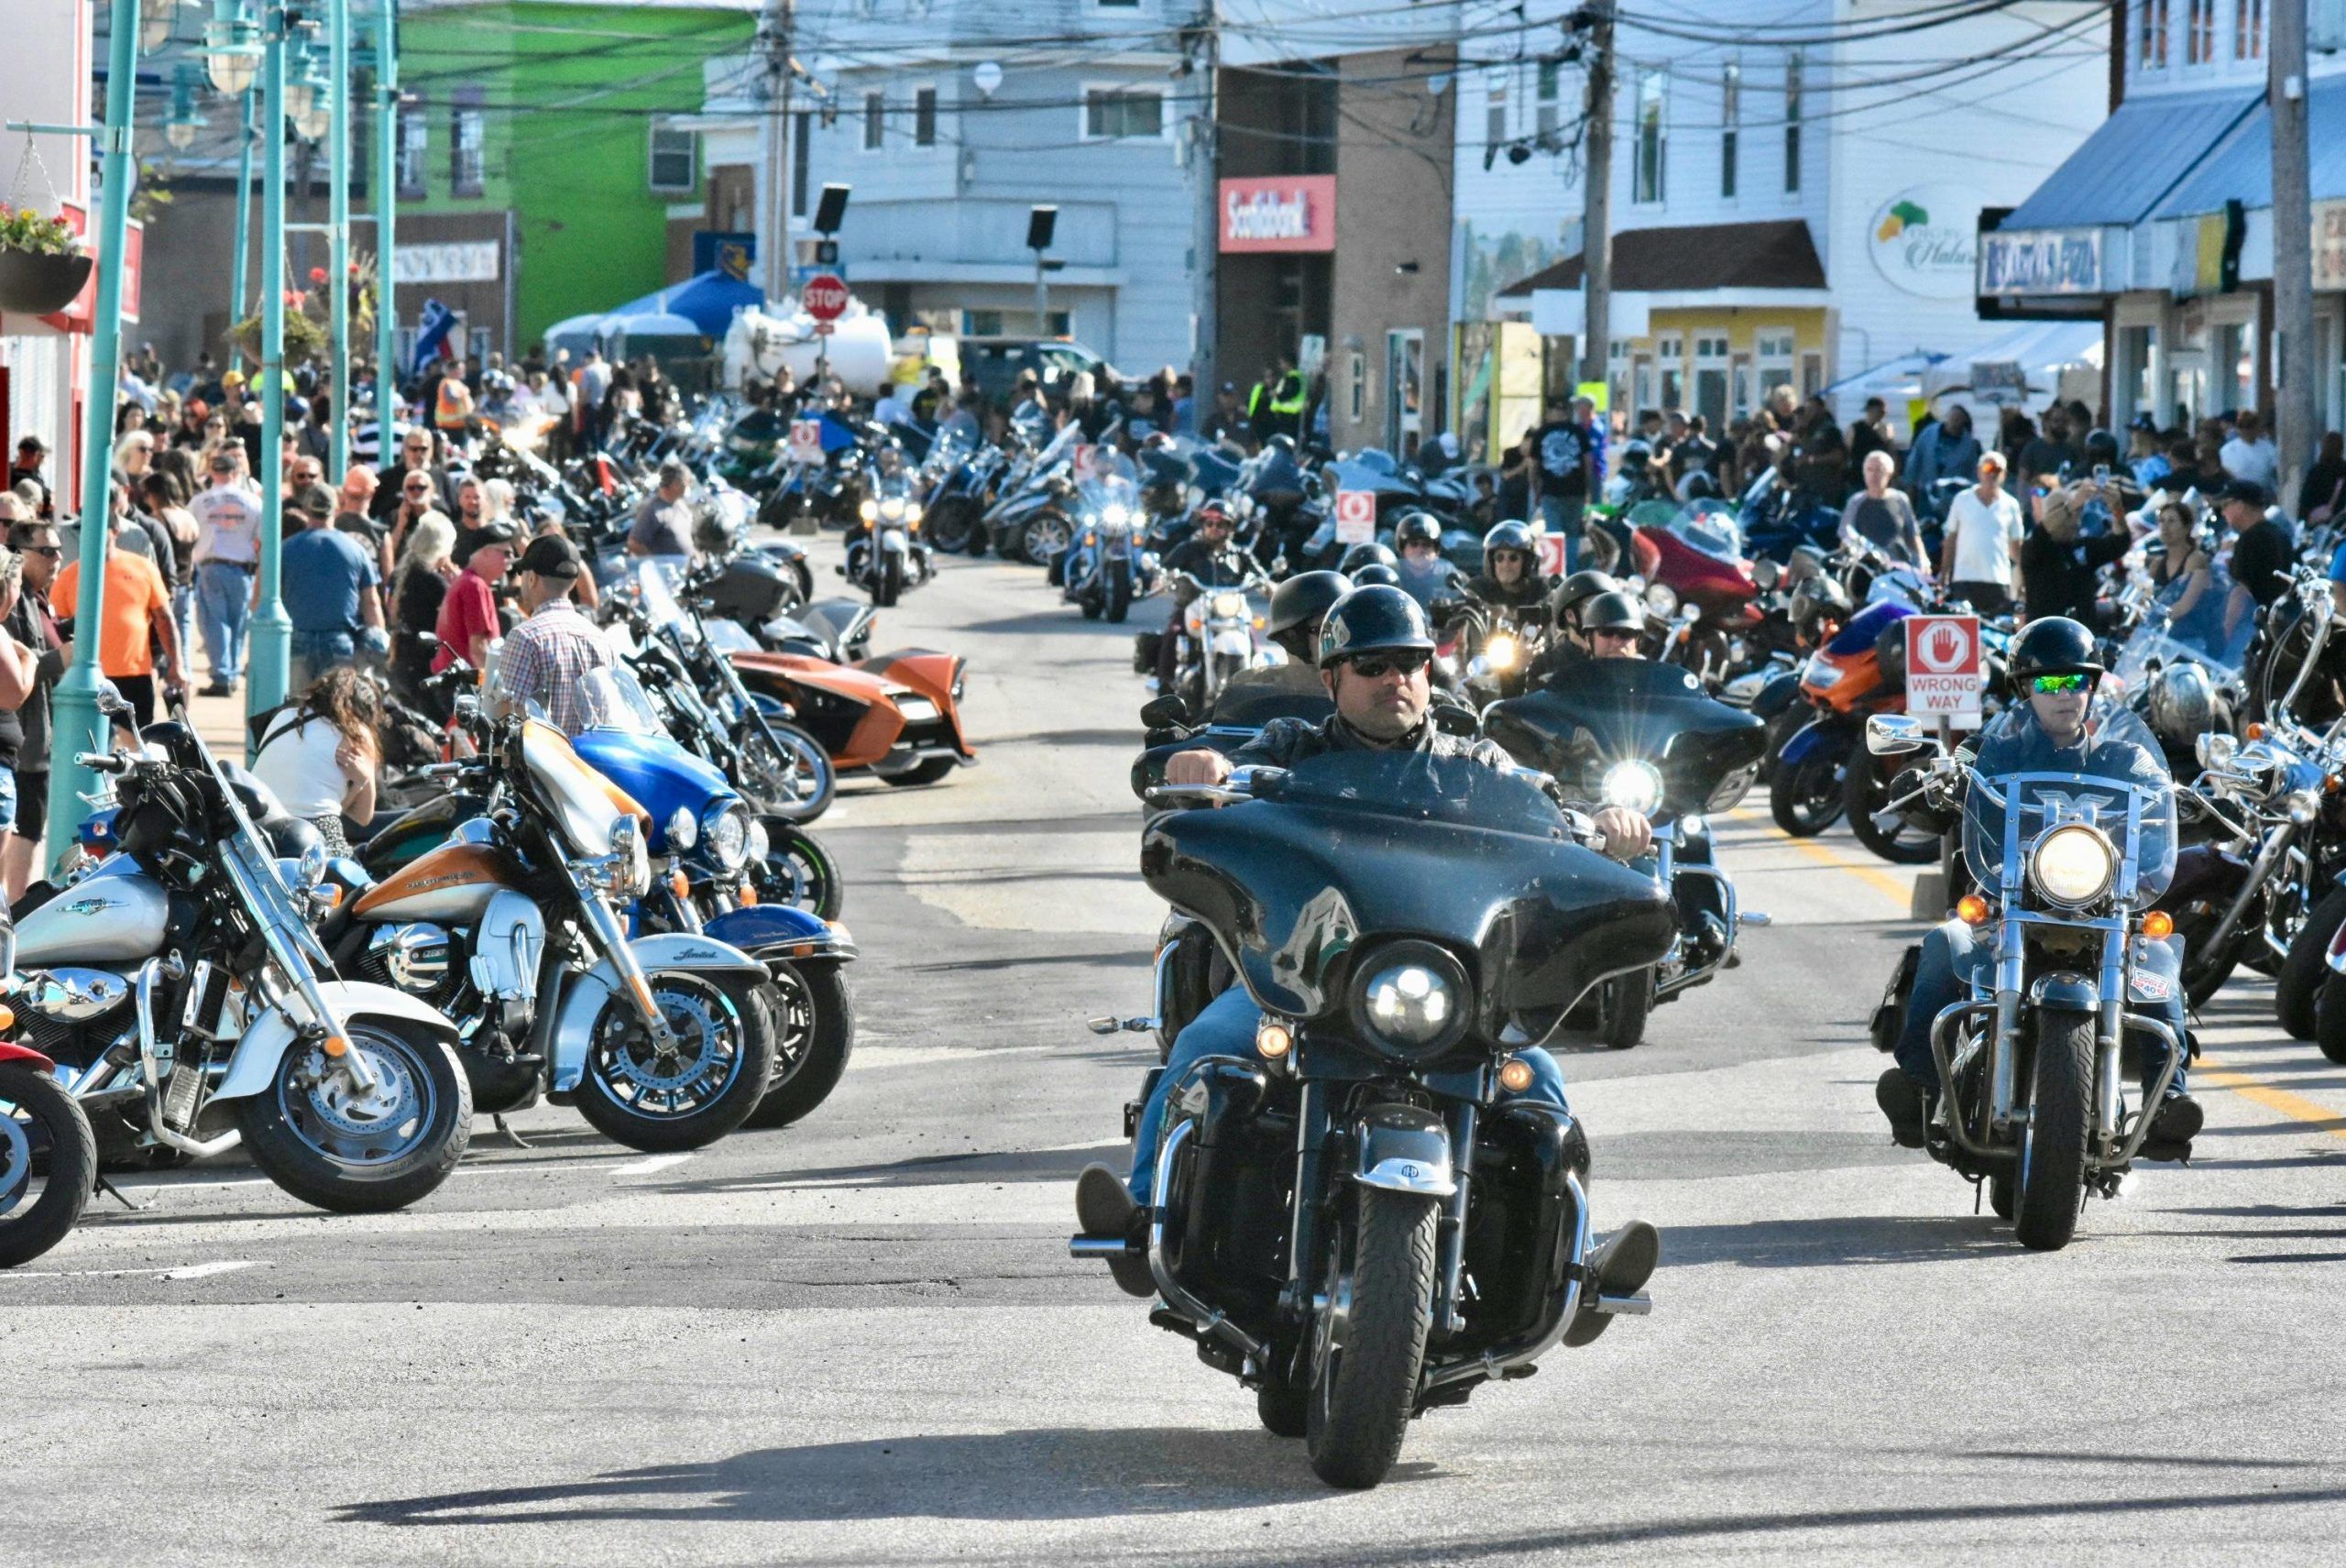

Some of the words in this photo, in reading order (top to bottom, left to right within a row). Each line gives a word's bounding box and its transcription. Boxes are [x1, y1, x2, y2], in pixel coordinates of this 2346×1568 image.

[805, 288, 847, 308] STOP
[1912, 677, 1977, 692] WRONG
[1926, 695, 1962, 708] WAY
[2143, 985, 2156, 993] 40
